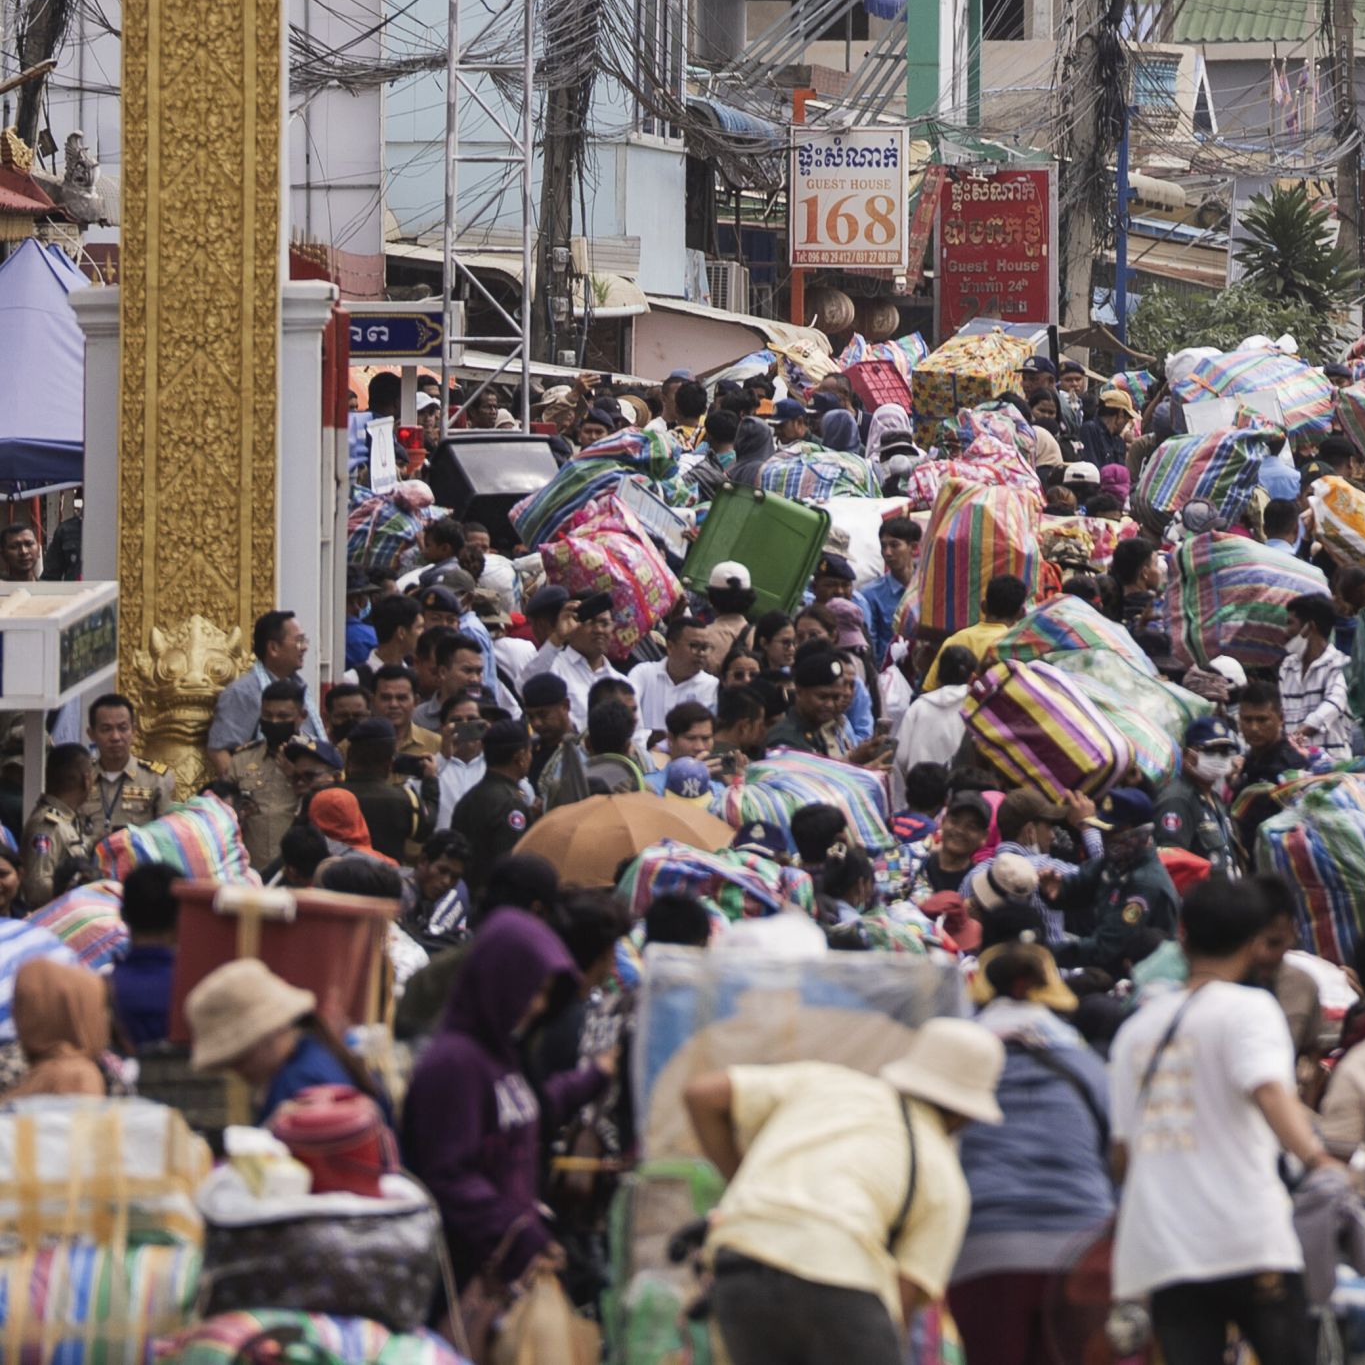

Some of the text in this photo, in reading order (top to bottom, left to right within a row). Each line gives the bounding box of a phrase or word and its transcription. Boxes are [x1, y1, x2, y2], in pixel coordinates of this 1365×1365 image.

[806, 178, 892, 190] GUEST HOUSE
[797, 194, 897, 246] 168
[948, 259, 1040, 272] Guest House
